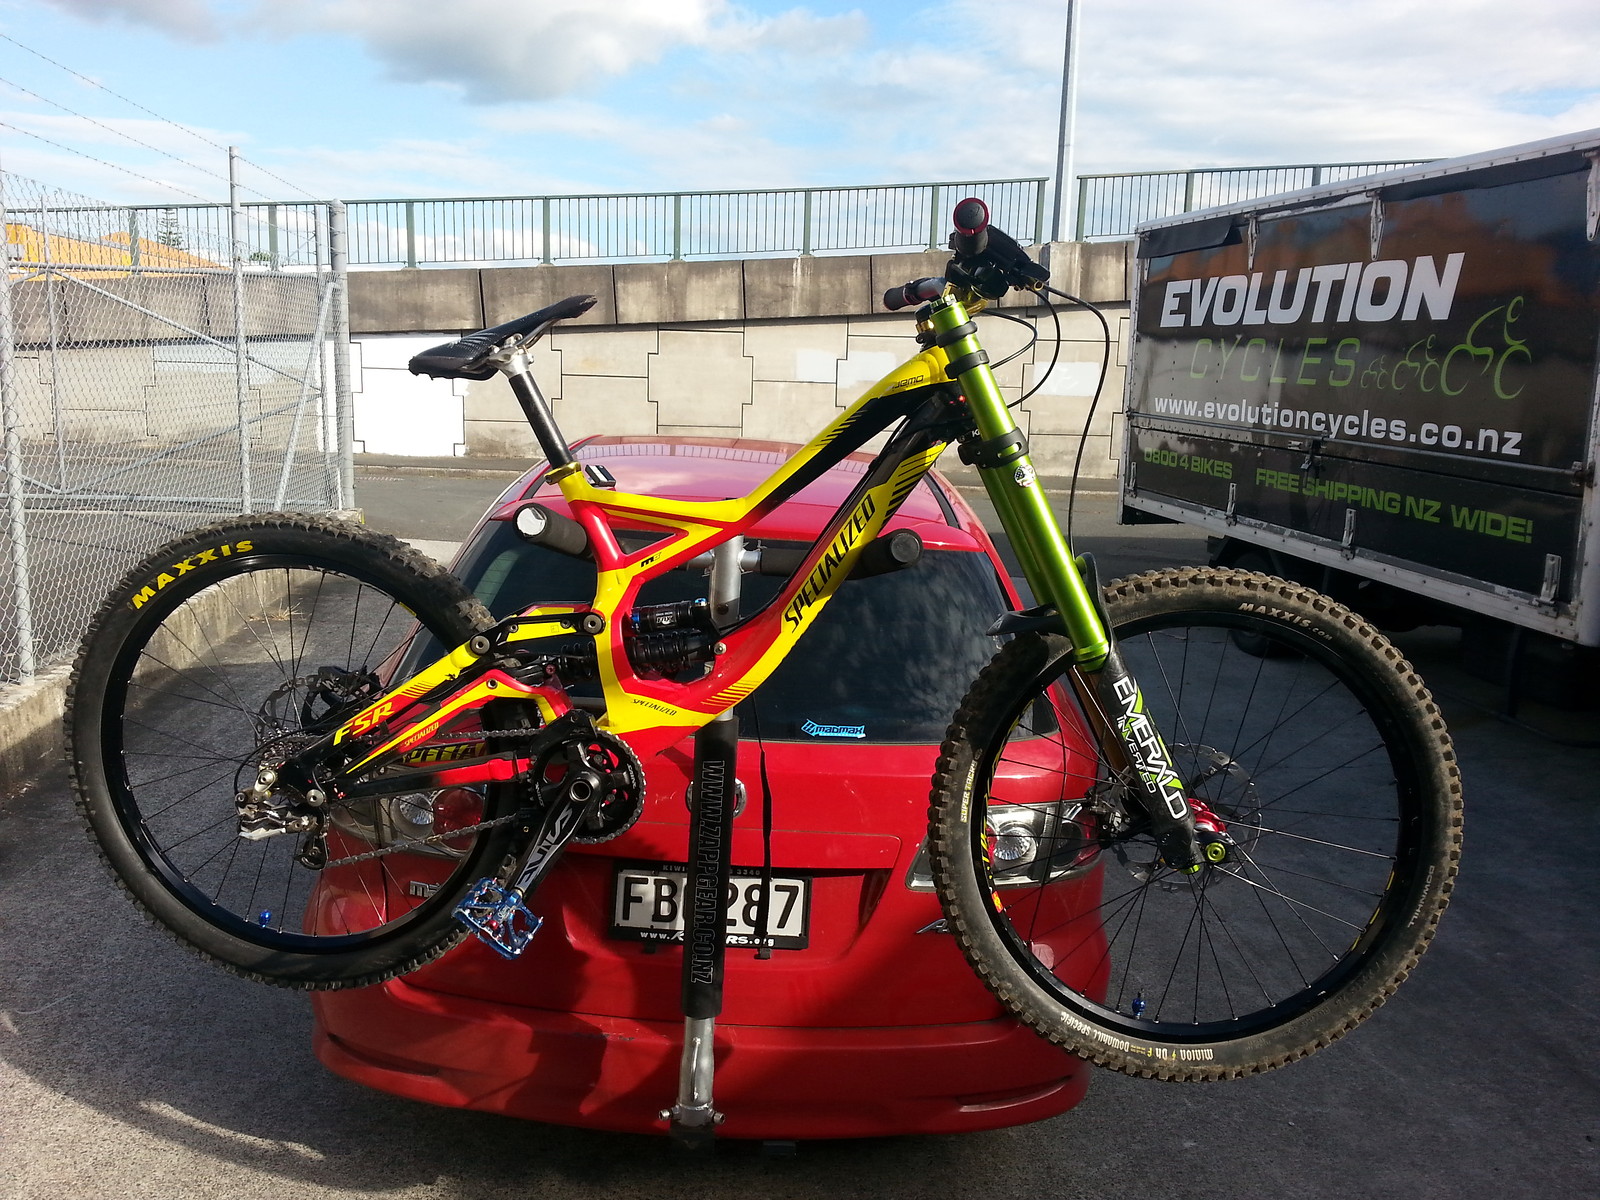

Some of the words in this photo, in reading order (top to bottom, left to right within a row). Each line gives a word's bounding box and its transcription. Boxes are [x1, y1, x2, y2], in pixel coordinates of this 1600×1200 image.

[1160, 252, 1466, 328] EVOLUTION
[1189, 337, 1361, 387] CYCLES
[1154, 397, 1523, 457] www.evolutioncycles.co.nz
[1144, 446, 1178, 468] 0800
[1179, 454, 1190, 470] 4
[1190, 456, 1233, 480] BIKES
[1256, 467, 1300, 493] FREE
[1302, 475, 1401, 515] SHIPPING
[1404, 495, 1442, 524] NZ
[1450, 503, 1534, 544] WIDE!
[131, 540, 255, 610] MAXXIS
[784, 493, 876, 634] SPECIALIZED
[332, 701, 395, 747] FSR
[403, 721, 440, 748] SPECIALIZED
[631, 698, 678, 717] SPECIALIZED
[1112, 675, 1189, 820] EMERALD
[1116, 713, 1158, 795] INVERTED
[960, 791, 971, 824] SUPER
[622, 876, 801, 929] FB287
[690, 760, 726, 985] WWW.ZAPPGEAR.CO.NZ
[1406, 865, 1436, 929] DOWNHILL
